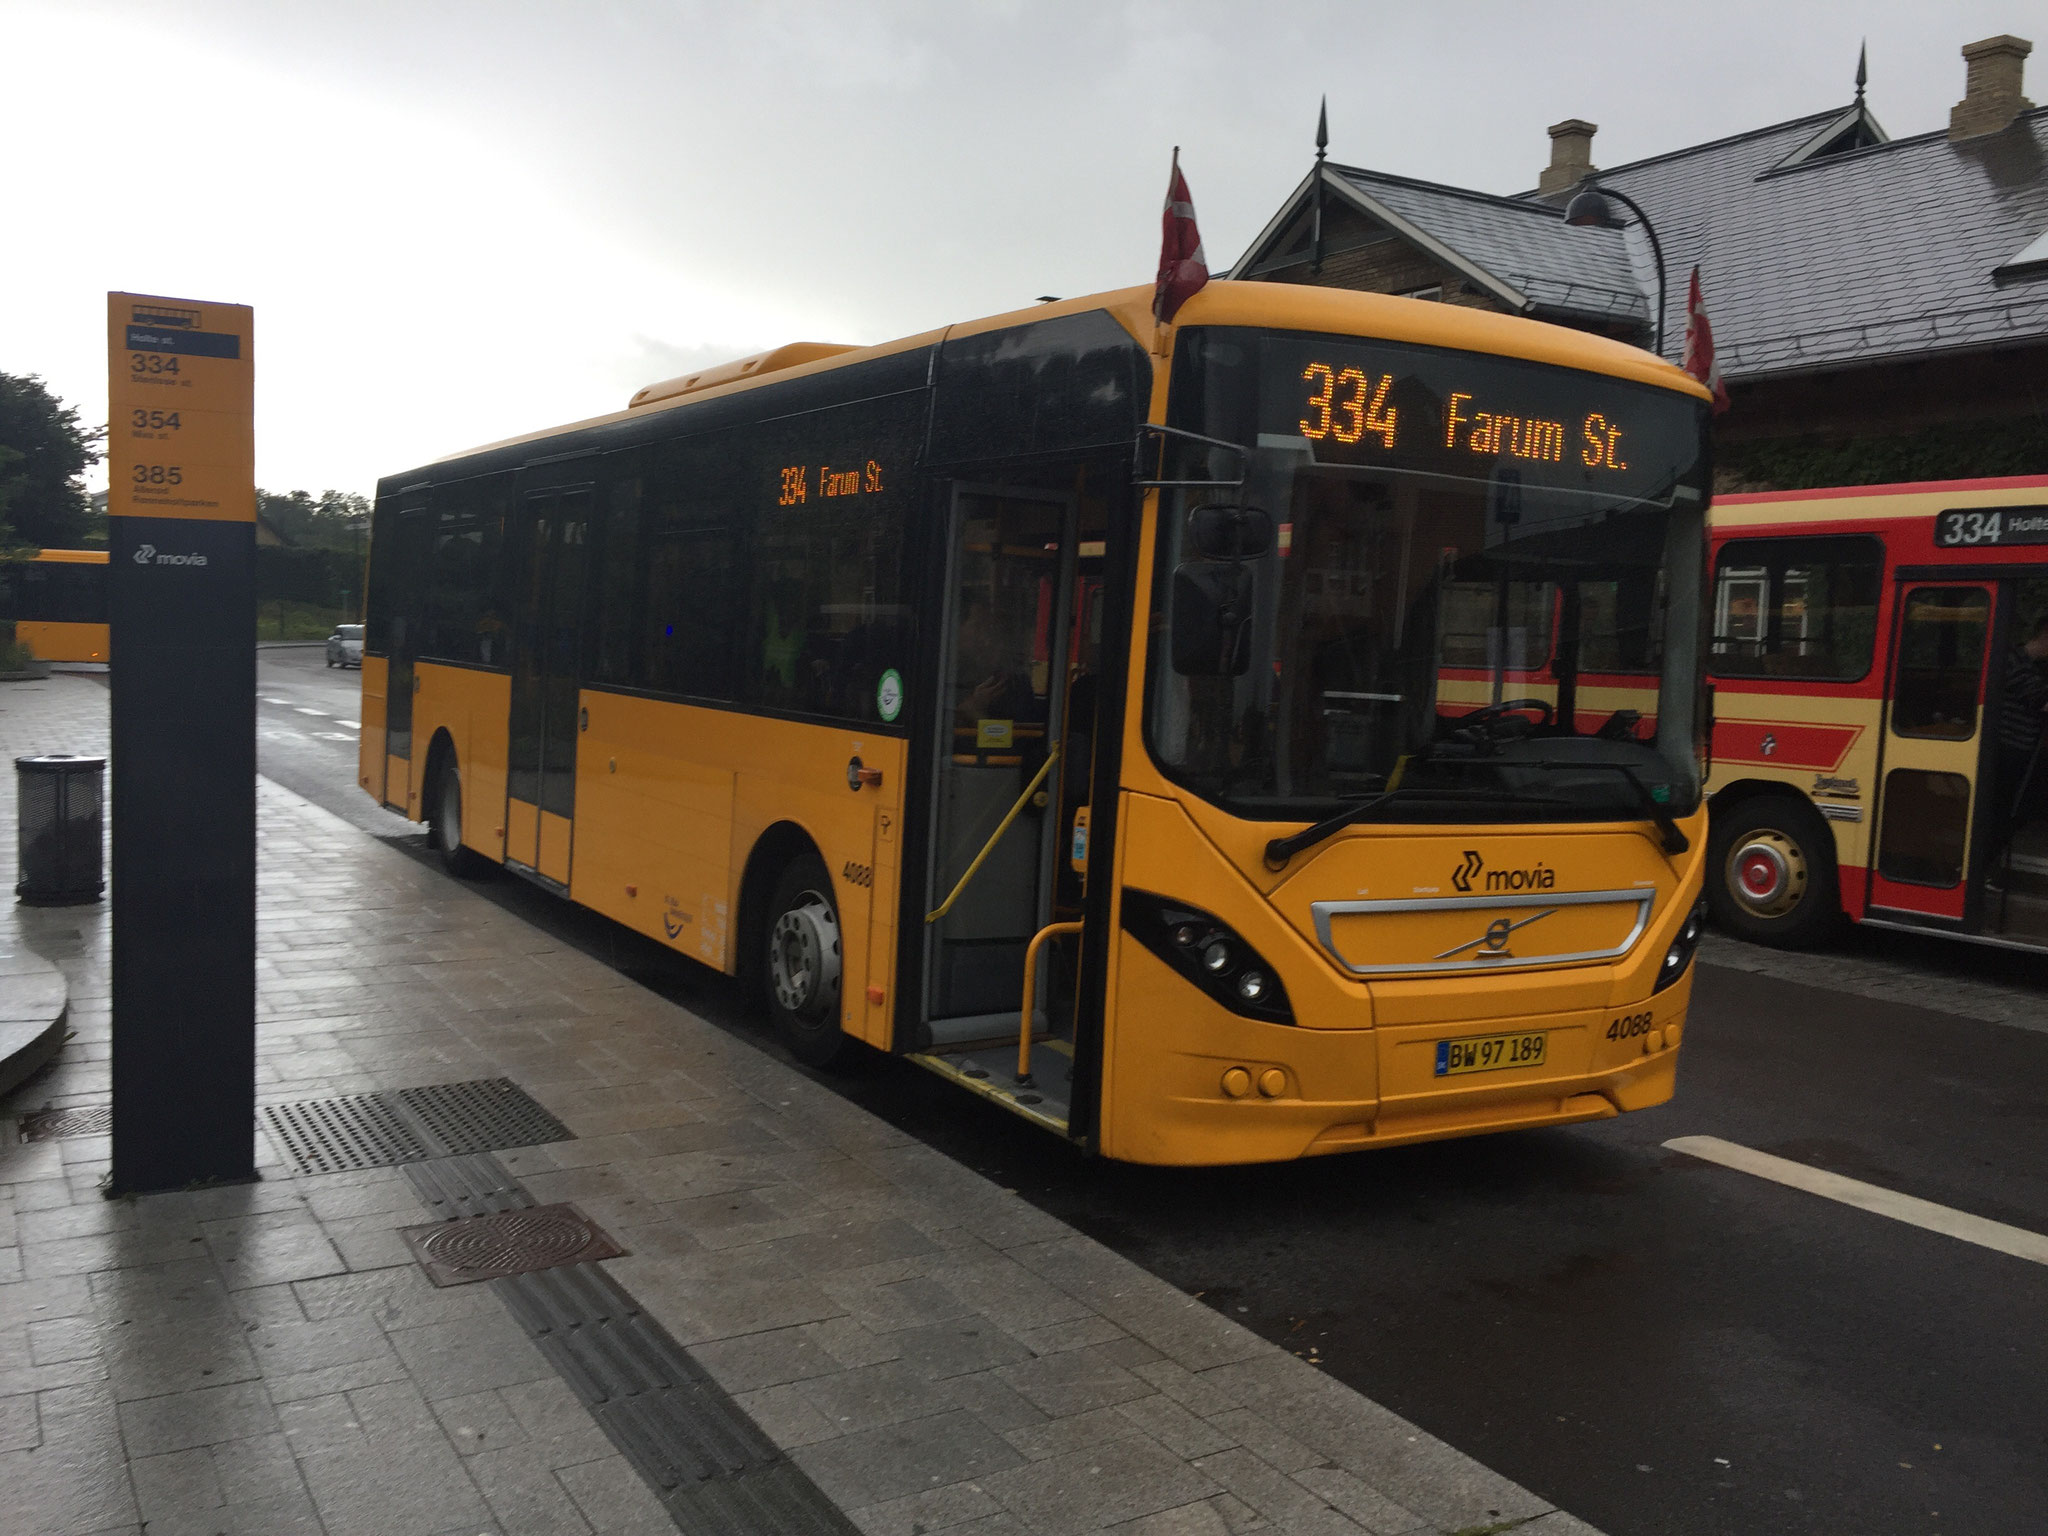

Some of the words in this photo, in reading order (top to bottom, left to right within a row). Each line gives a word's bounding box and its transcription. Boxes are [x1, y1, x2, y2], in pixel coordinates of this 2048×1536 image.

[131, 353, 180, 375] 334
[132, 409, 182, 430] 354
[1300, 361, 1397, 448] 334
[1444, 393, 1563, 463] Farum
[1582, 413, 1627, 470] St.
[132, 464, 183, 485] 385
[779, 465, 807, 506] 334
[820, 466, 859, 497] Farum
[865, 460, 884, 493] St.
[1944, 512, 2002, 544] 334
[156, 552, 208, 566] movia
[843, 861, 873, 888] 4088
[1486, 863, 1555, 890] movia
[1606, 1012, 1652, 1042] 4088
[1481, 1040, 1504, 1065] 97
[1510, 1036, 1544, 1062] 189
